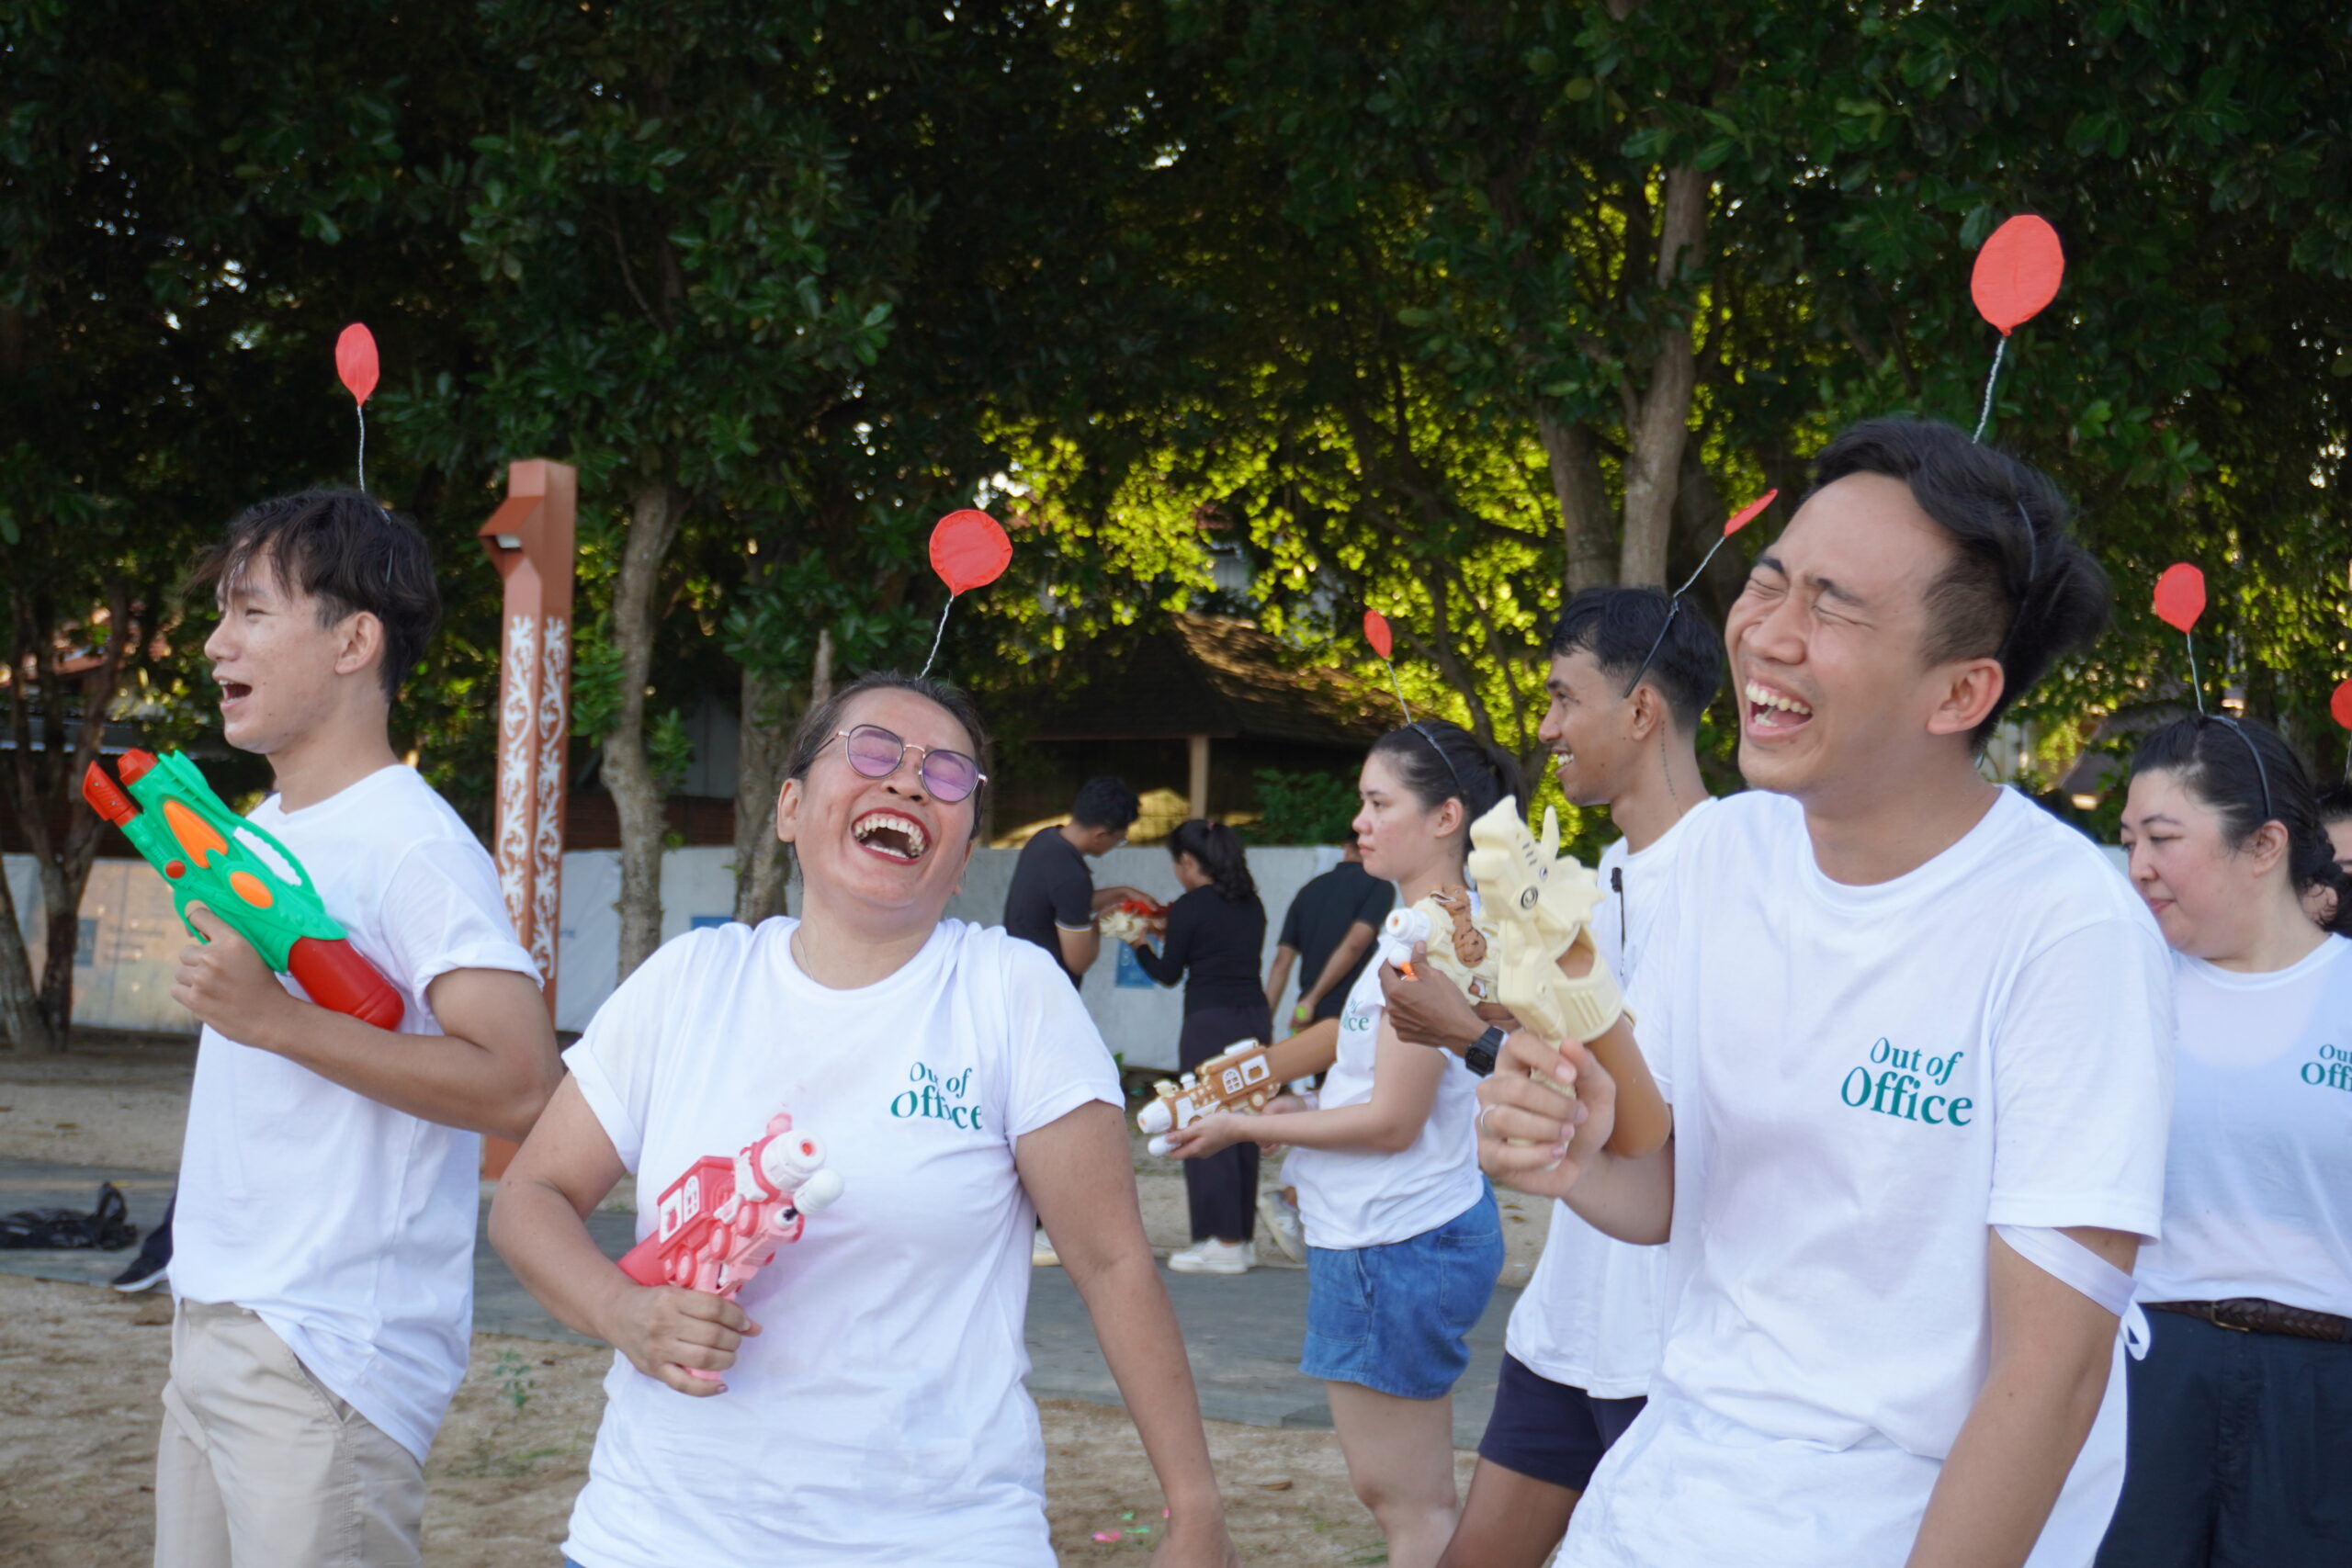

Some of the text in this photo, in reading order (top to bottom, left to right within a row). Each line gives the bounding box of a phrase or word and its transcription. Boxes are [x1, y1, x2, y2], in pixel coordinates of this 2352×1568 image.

[946, 1067, 972, 1099] of
[1870, 1037, 1963, 1086] Out of
[1841, 1066, 1973, 1126] Office
